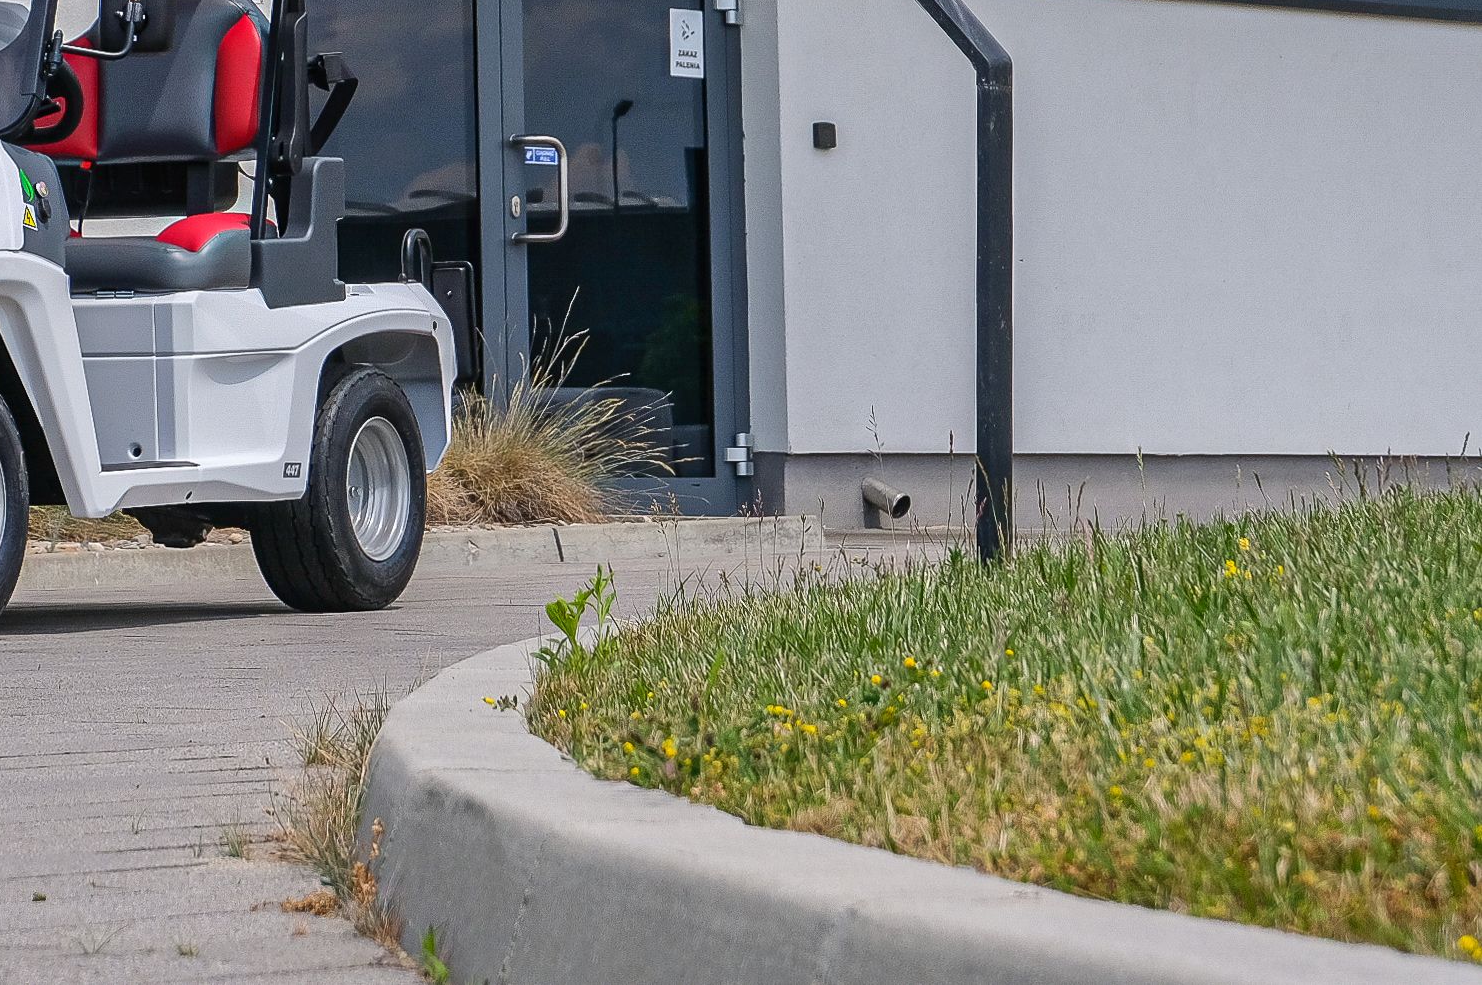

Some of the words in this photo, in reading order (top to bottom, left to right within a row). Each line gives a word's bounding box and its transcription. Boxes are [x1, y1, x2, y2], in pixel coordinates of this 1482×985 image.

[678, 49, 697, 58] ZAKAZ
[675, 61, 700, 69] PALENIA
[286, 464, 300, 476] 447
